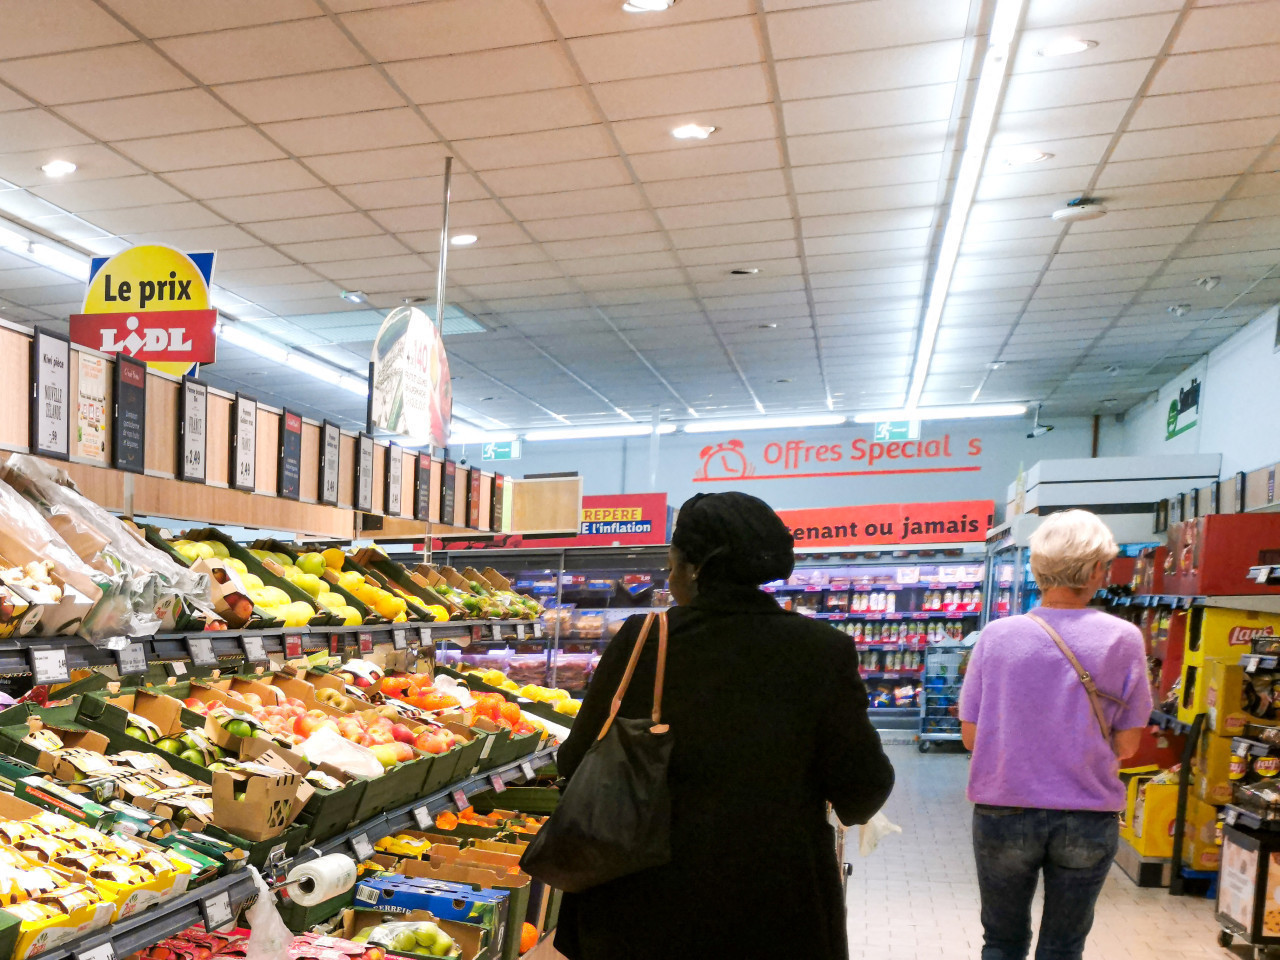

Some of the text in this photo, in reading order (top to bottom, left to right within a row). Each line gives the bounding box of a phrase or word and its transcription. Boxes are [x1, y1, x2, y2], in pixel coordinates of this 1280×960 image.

[104, 271, 192, 309] Le prix
[763, 440, 843, 470] Offres
[592, 521, 651, 536] l'inflation
[865, 519, 894, 538] ou
[902, 515, 979, 540] jamais
